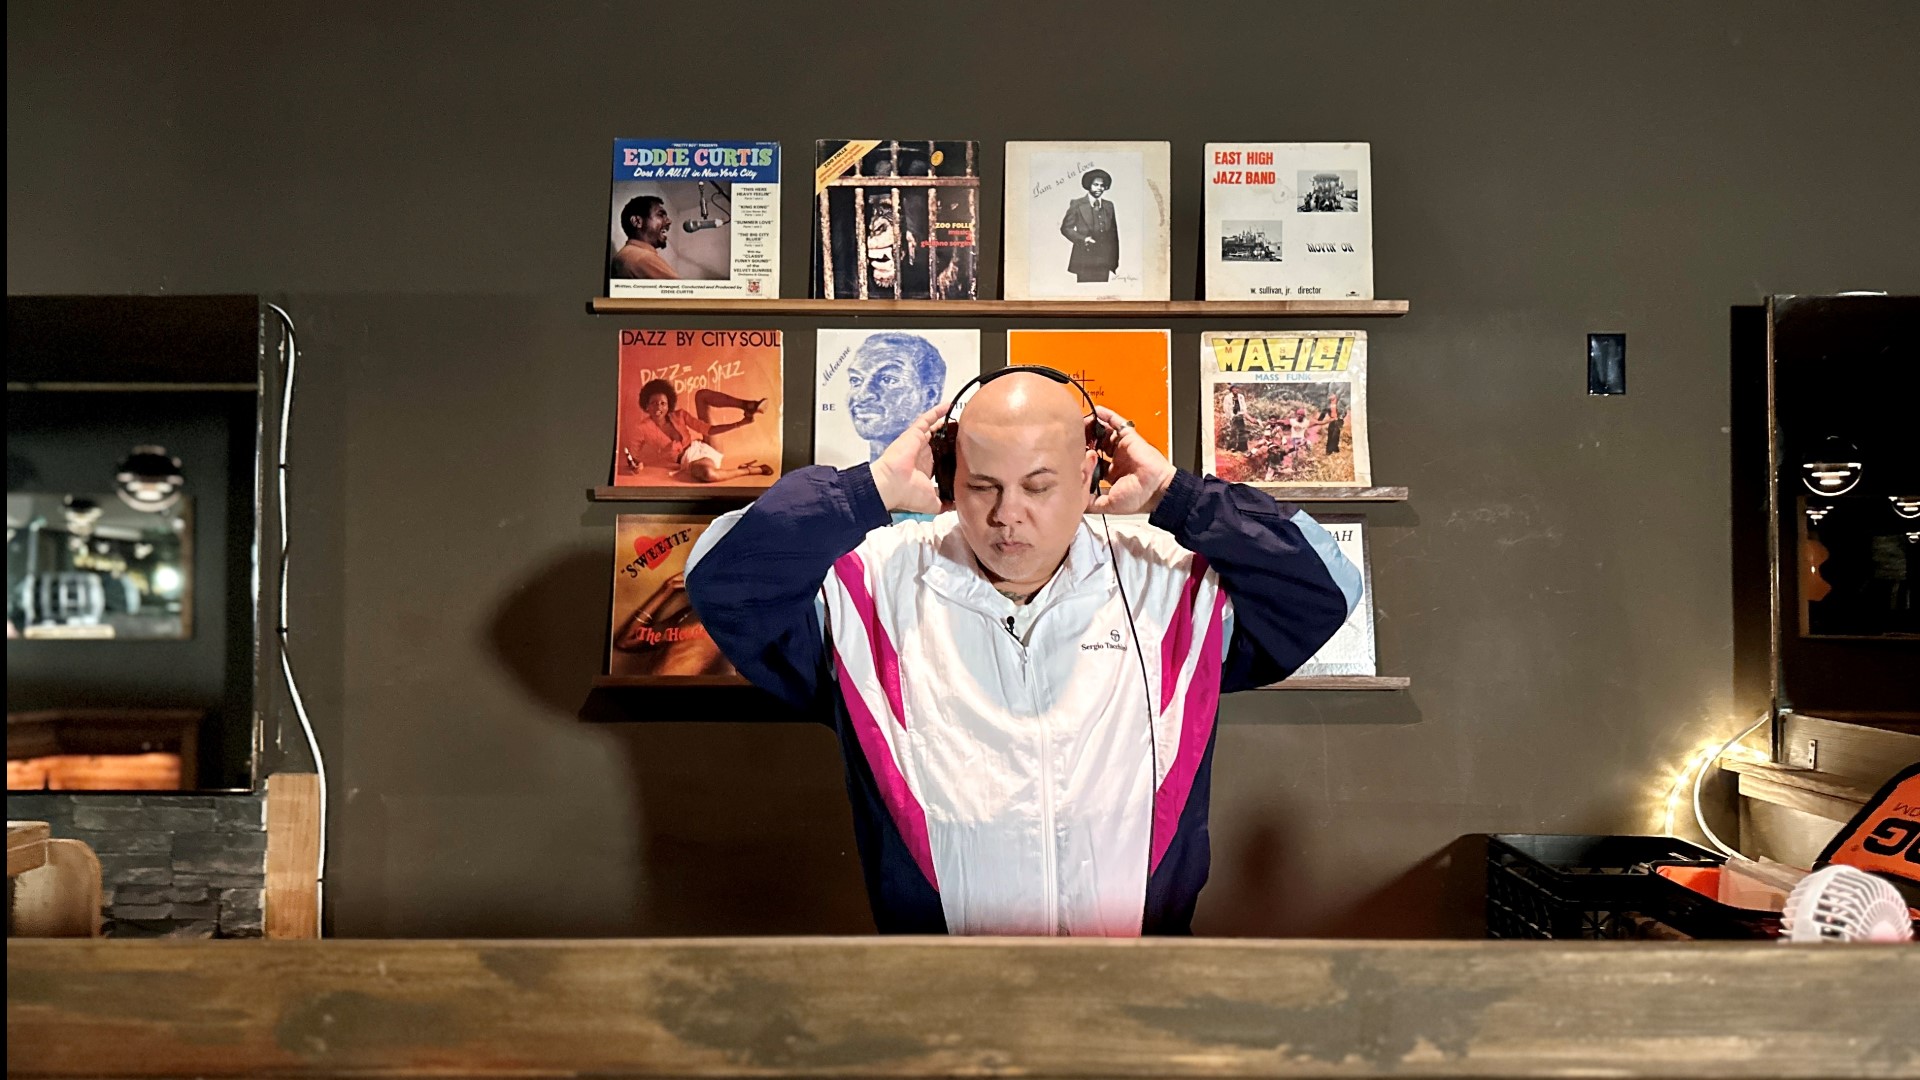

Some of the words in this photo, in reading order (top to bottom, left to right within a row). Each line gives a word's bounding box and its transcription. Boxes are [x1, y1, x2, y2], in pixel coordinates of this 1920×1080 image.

[623, 148, 690, 167] EDDIE
[694, 148, 773, 168] CURTIS
[1214, 151, 1242, 165] EAST
[1246, 151, 1274, 165] HIGH
[633, 167, 654, 177] Does
[655, 168, 665, 177] It
[691, 169, 701, 177] in
[701, 168, 719, 178] New
[719, 168, 739, 177] York
[739, 168, 757, 180] City
[1212, 171, 1242, 184] JAZZ
[1245, 171, 1276, 184] BAND
[1259, 285, 1284, 296] sullivan,
[1297, 285, 1322, 295] director
[621, 331, 667, 347] DAZZ
[676, 331, 696, 347] BY
[701, 331, 738, 347] CITY
[739, 331, 781, 348] SOUL
[1212, 337, 1356, 372] MASISI
[675, 374, 708, 394] DISCO
[706, 360, 745, 384] JAZZ
[1255, 373, 1280, 381] MASS
[1286, 373, 1312, 381] FUNK
[822, 403, 837, 411] BE
[1327, 530, 1354, 542] AH
[636, 626, 662, 646] The
[1081, 642, 1104, 652] Sergio
